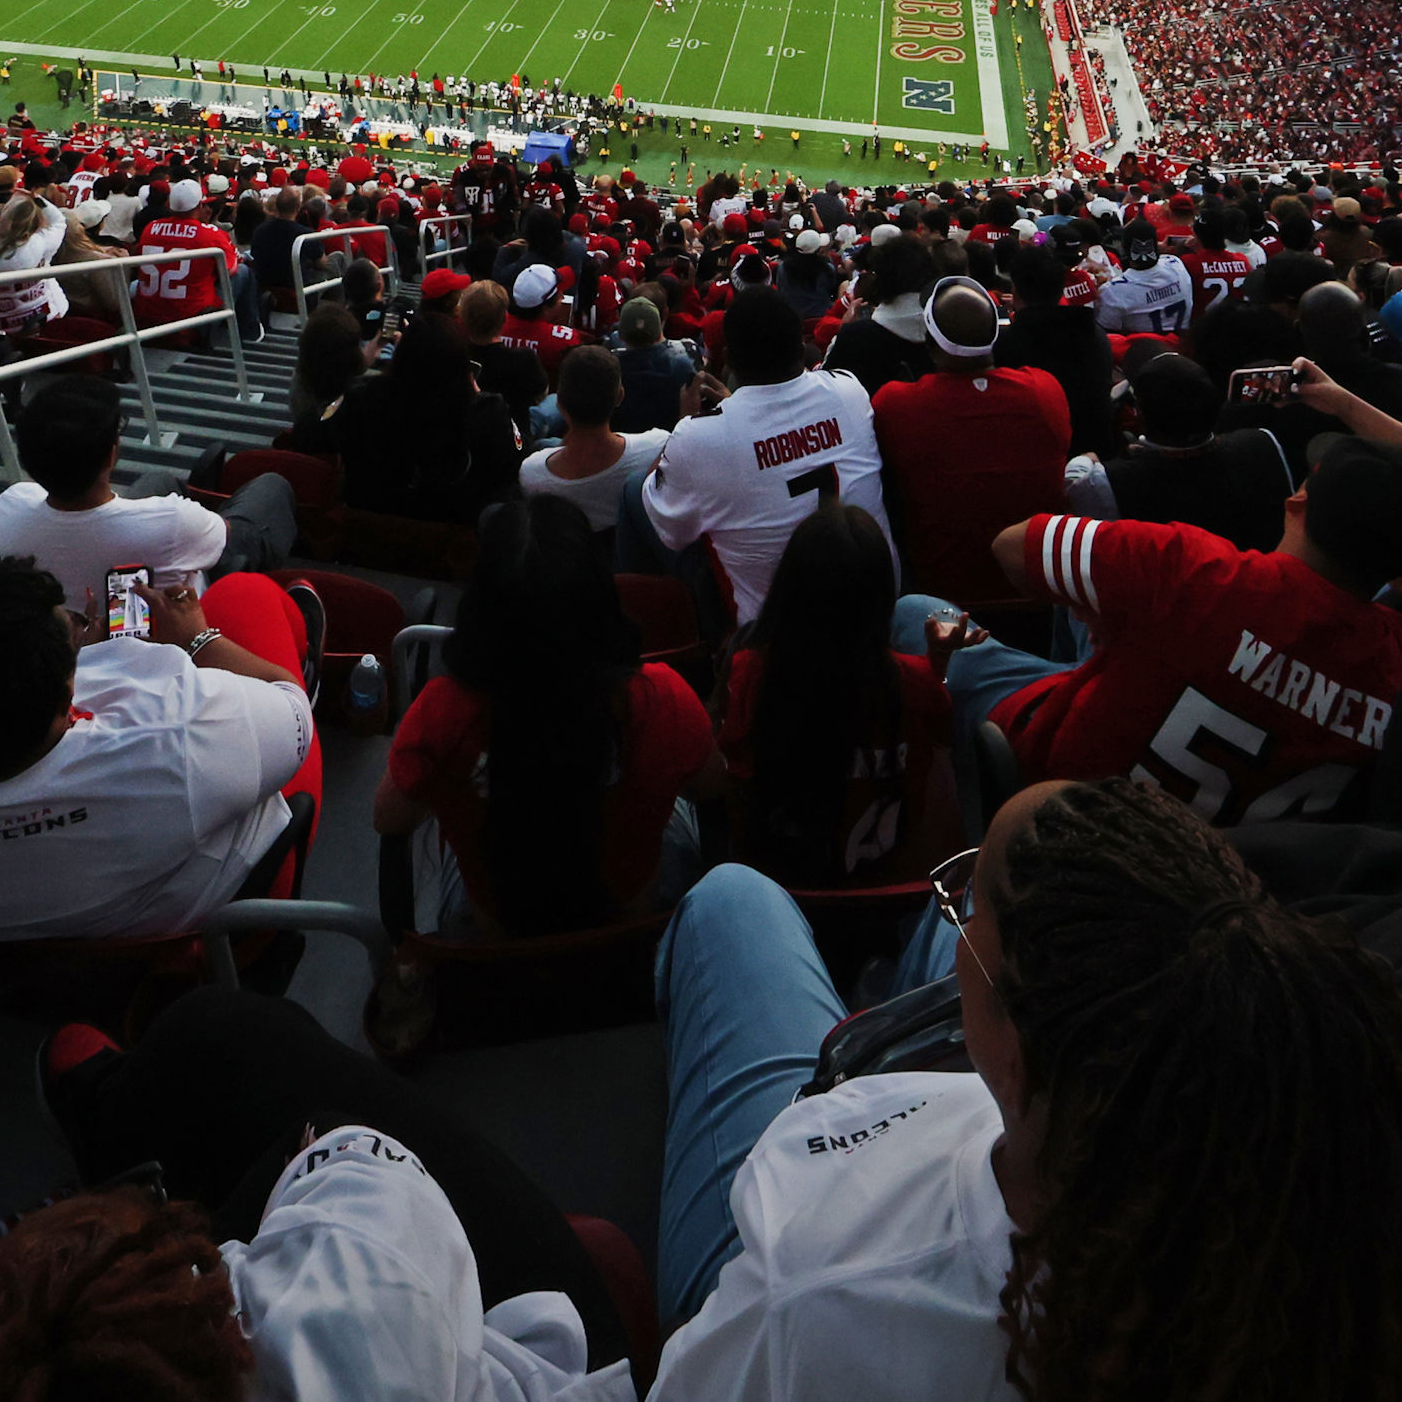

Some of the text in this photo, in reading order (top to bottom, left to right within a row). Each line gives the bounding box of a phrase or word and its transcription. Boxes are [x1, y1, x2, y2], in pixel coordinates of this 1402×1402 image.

[392, 13, 424, 25] 50
[574, 29, 606, 42] 30
[978, 31, 992, 42] OF
[667, 37, 700, 50] 20
[980, 46, 994, 58] US
[150, 222, 198, 239] WILLIS
[140, 245, 193, 299] 52
[1145, 279, 1181, 304] AUBREY
[753, 417, 843, 471] ROBINSON
[1227, 628, 1393, 751] WARNER
